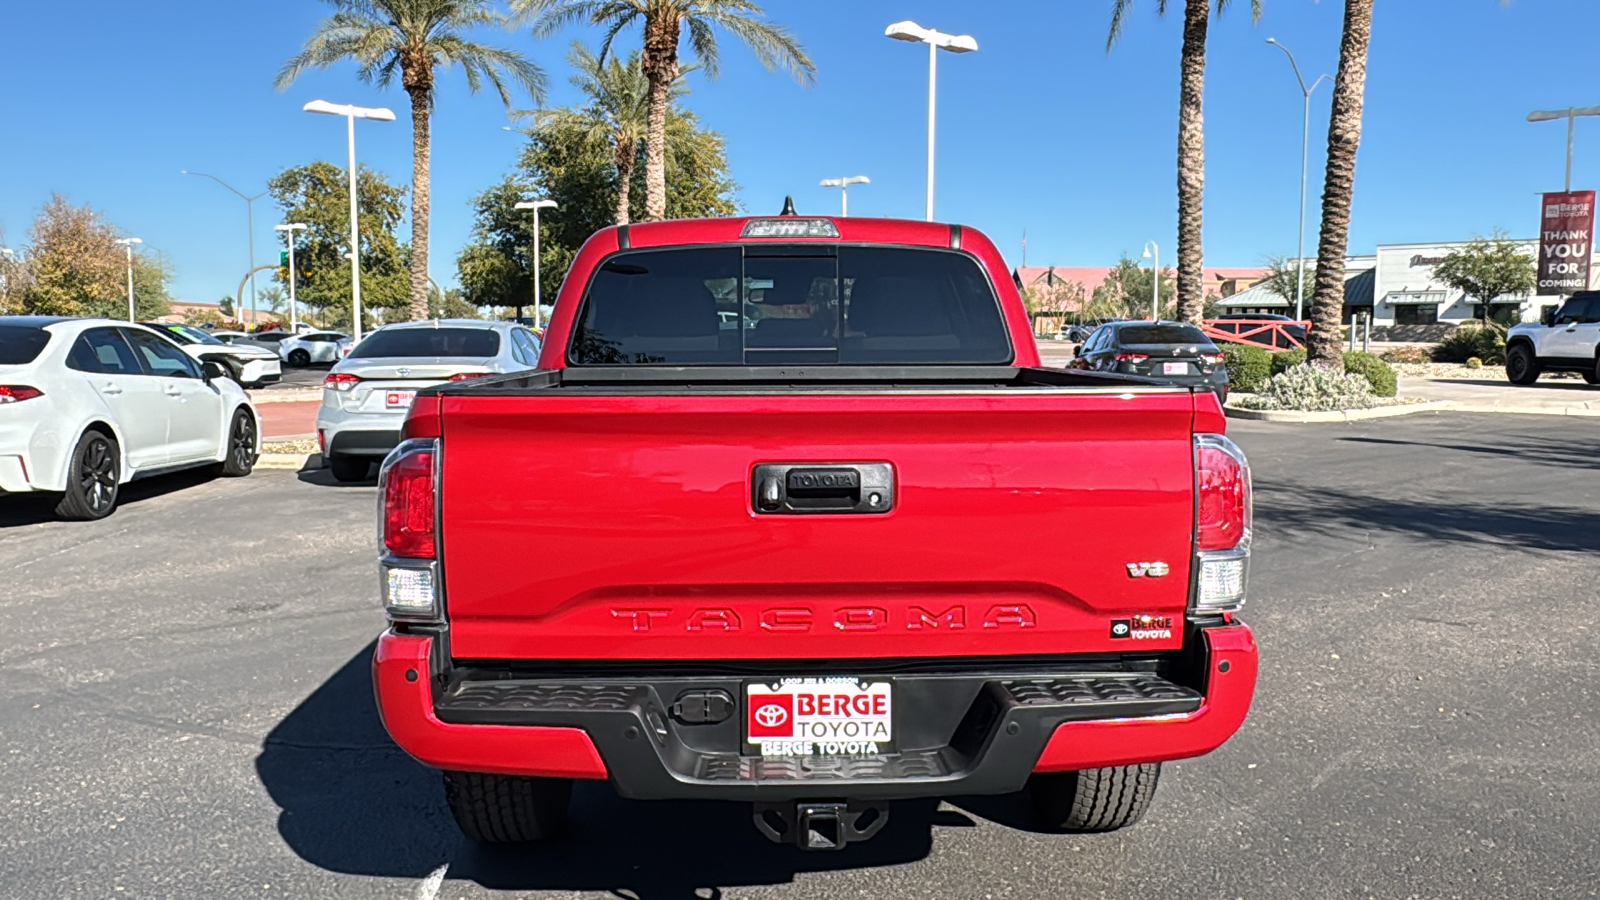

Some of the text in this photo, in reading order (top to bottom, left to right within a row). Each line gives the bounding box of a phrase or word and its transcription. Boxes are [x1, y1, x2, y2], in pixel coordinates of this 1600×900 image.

[1560, 203, 1590, 212] BERGE
[1560, 210, 1589, 218] TOYOTA
[1543, 230, 1588, 241] THANK
[1544, 243, 1586, 258] YOU
[1548, 262, 1579, 275] FOR
[1539, 279, 1586, 288] COMING!
[793, 474, 855, 487] TOYOTA
[1126, 561, 1169, 578] V6
[610, 603, 1037, 633] TACOMA
[1131, 616, 1172, 629] BERGE
[1130, 630, 1172, 640] TOYOTA
[780, 677, 803, 685] LOOP
[797, 693, 887, 718] BERGE
[797, 721, 888, 738] TOYOTA
[761, 740, 879, 757] BERGE TOYOTA
